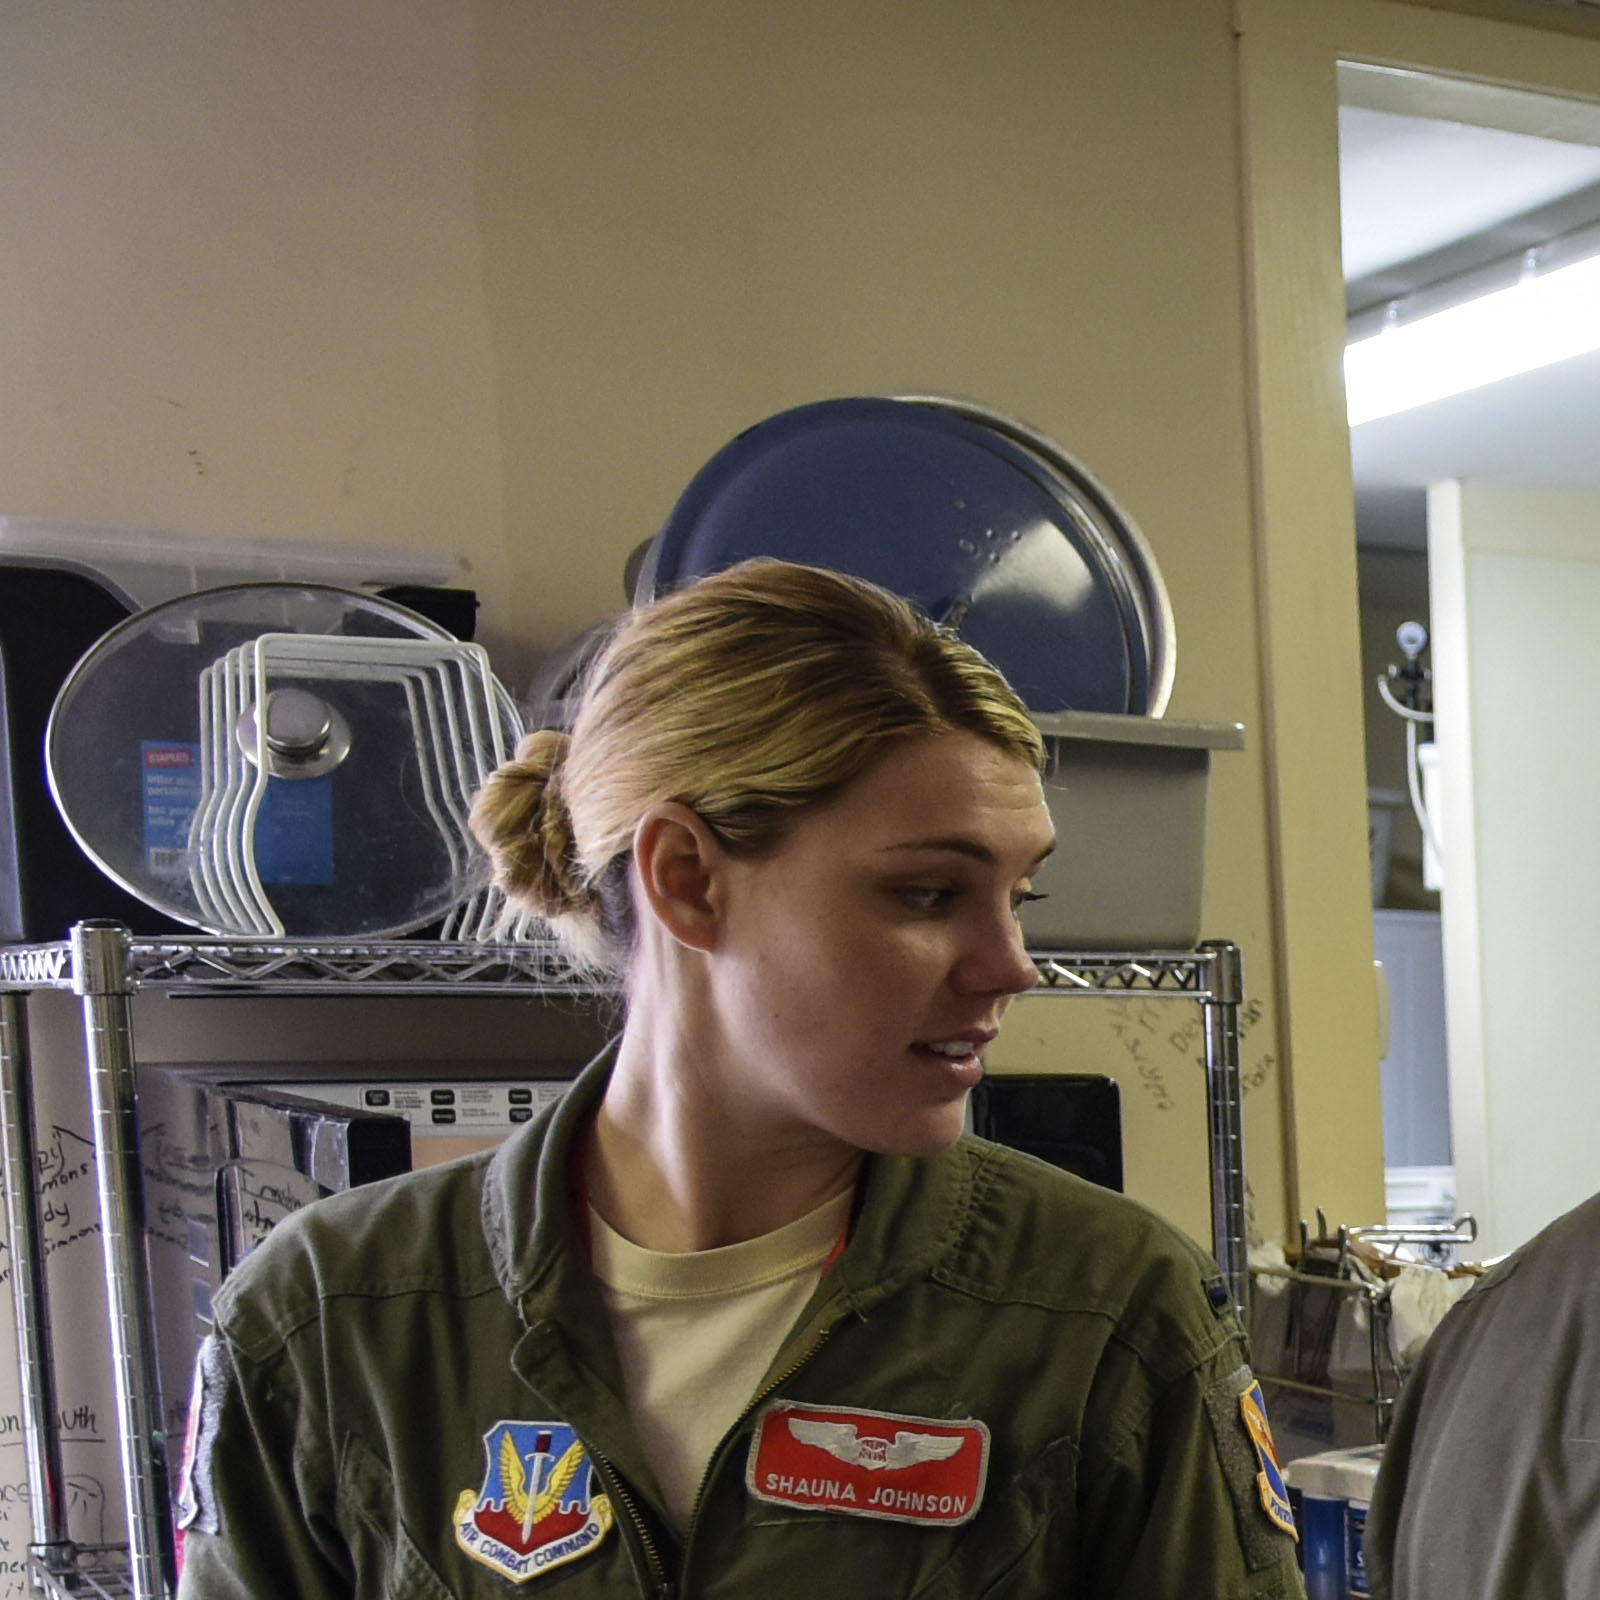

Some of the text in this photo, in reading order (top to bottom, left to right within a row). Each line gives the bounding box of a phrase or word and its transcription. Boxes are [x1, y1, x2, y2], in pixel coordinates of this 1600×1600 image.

[148, 753, 190, 763] STAPLES
[766, 1473, 967, 1514] SHAUNA JOHNSON
[461, 1521, 600, 1574] AIR COMBAT COMMAND
